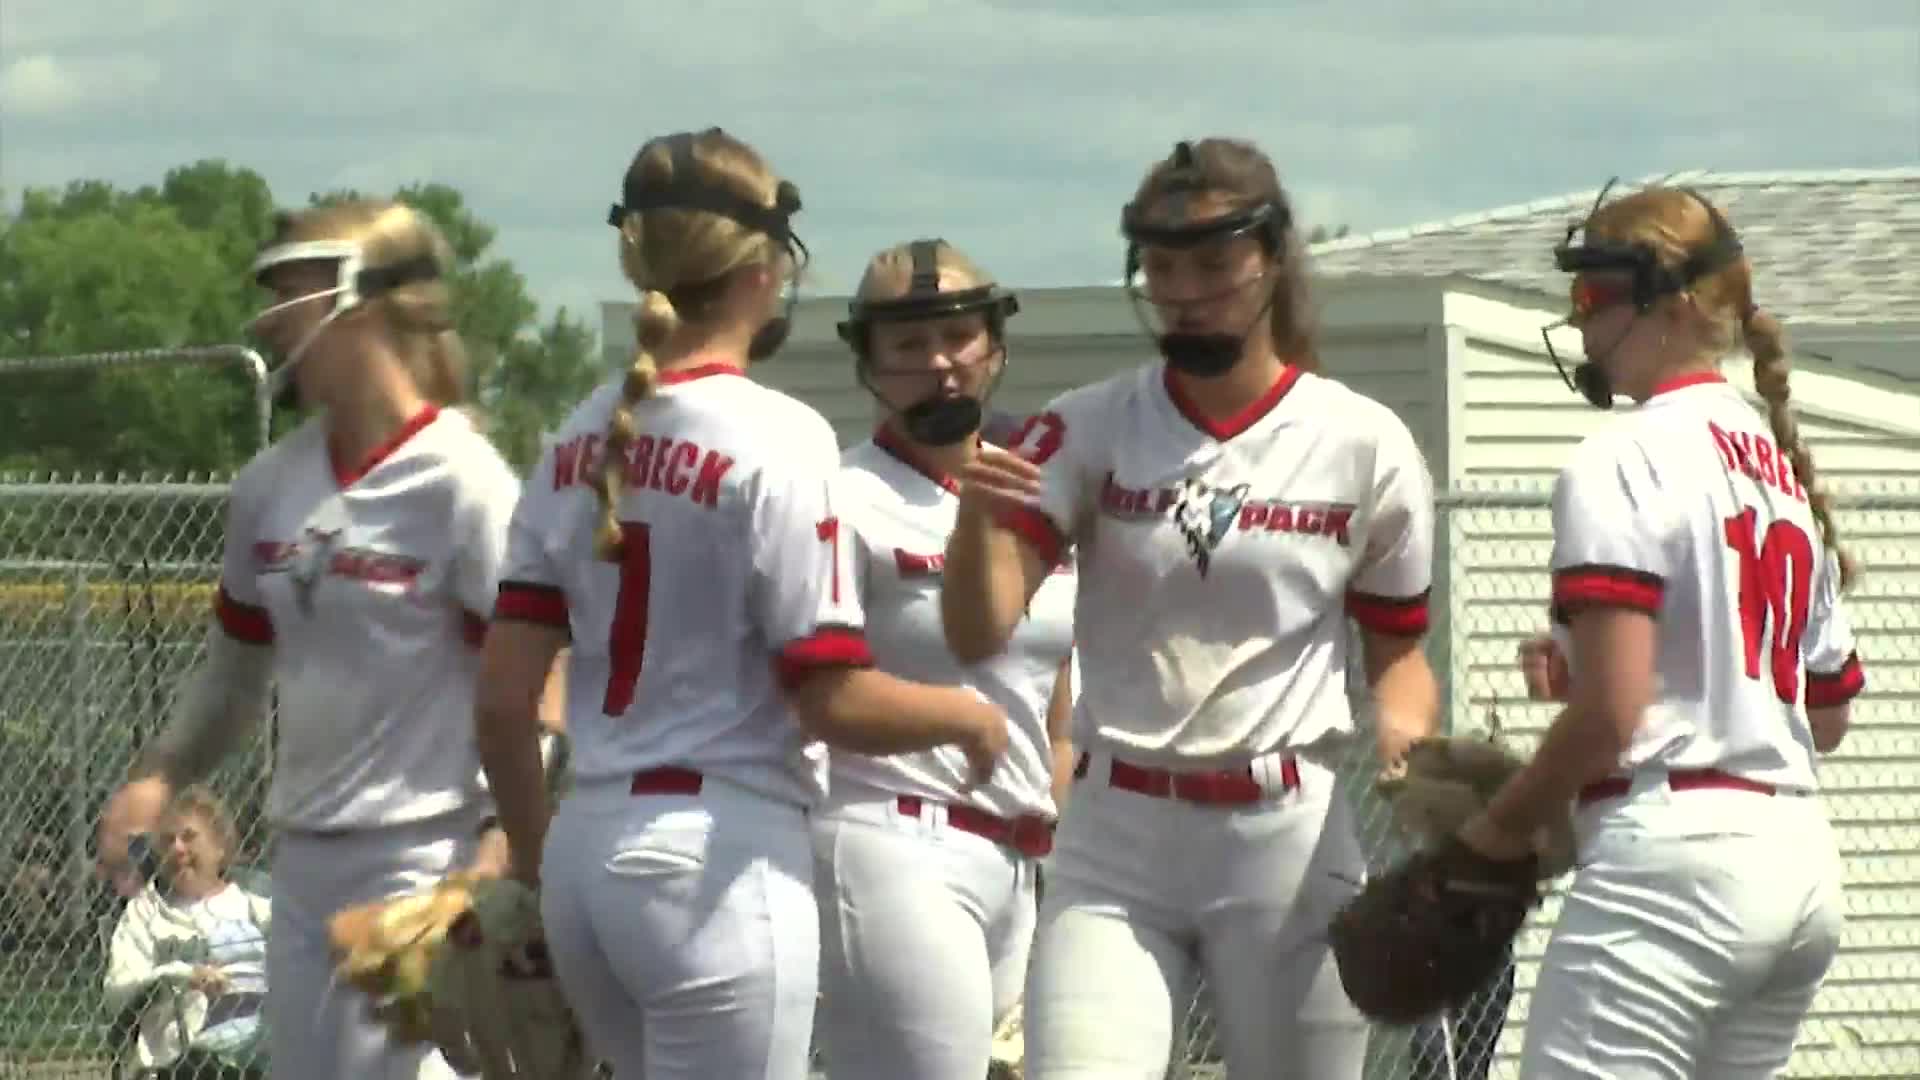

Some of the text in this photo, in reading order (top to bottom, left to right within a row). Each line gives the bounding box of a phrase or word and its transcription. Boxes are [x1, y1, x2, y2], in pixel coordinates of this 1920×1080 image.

[553, 432, 735, 510] WEBECK
[1238, 502, 1355, 544] PACK
[1724, 504, 1814, 705] 10
